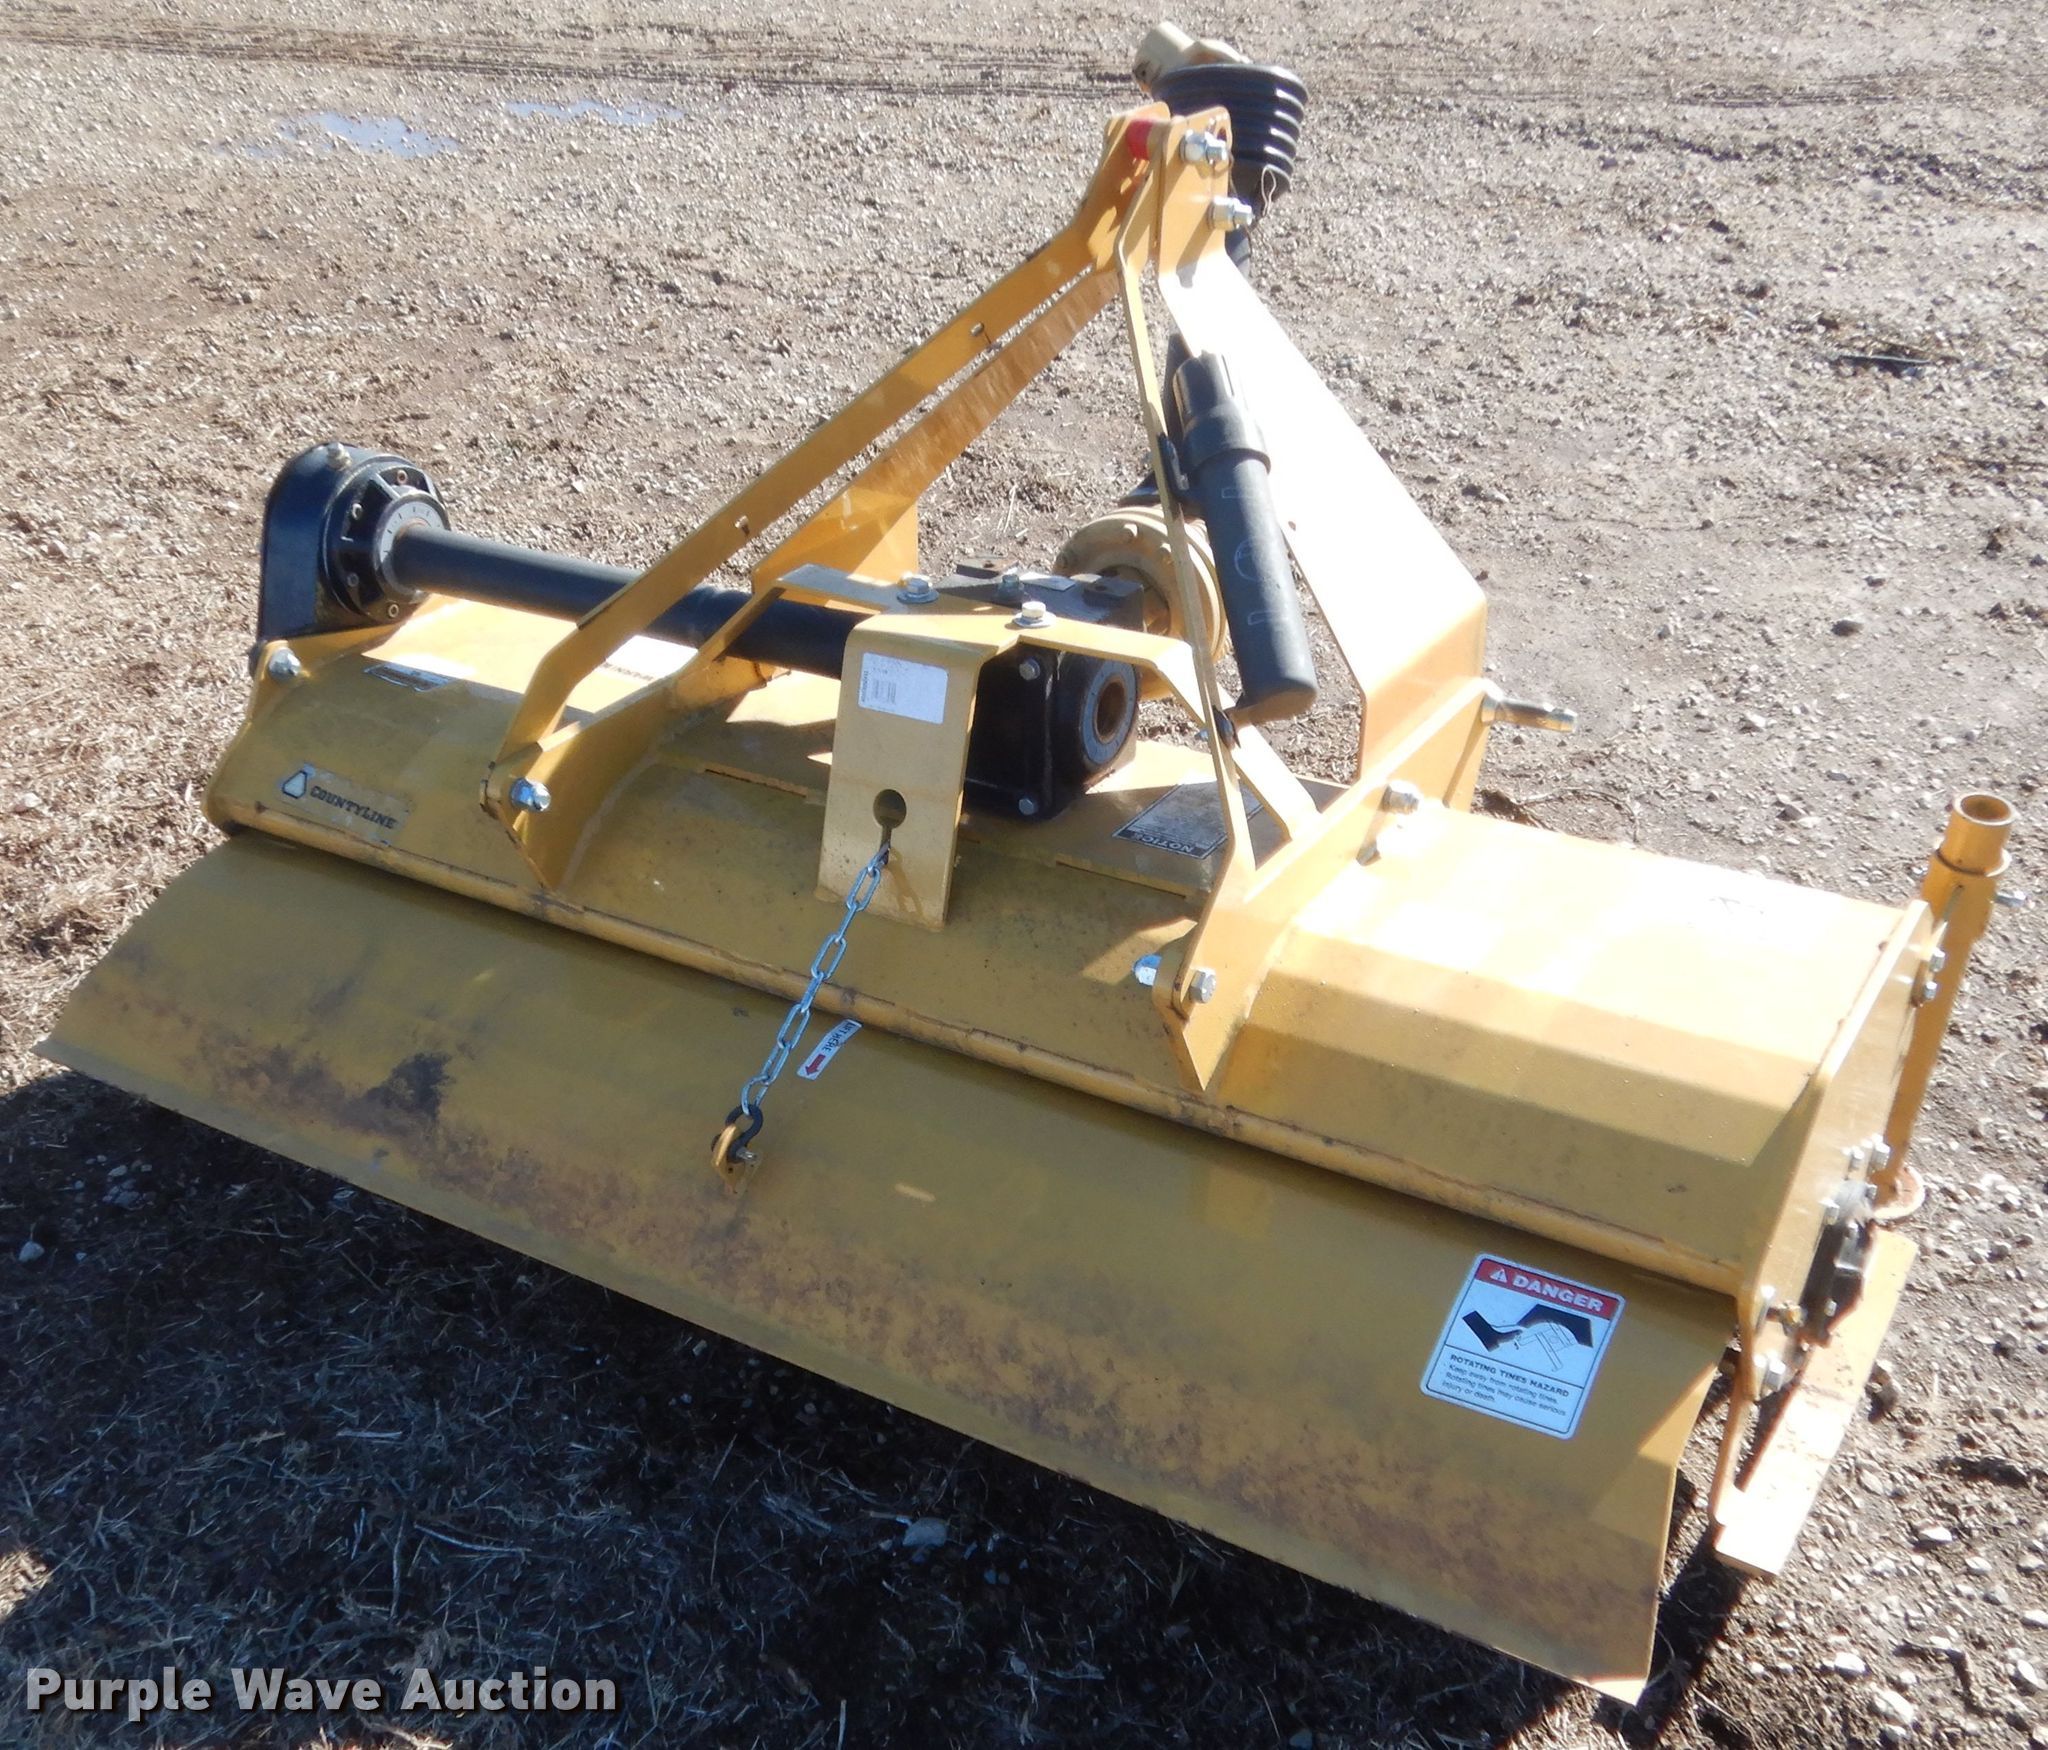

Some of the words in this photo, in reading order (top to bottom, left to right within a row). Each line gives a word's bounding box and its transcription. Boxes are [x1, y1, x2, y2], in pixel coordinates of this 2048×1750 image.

[310, 785, 398, 830] COUNTYLINE
[821, 1032, 842, 1052] HERE
[1512, 1273, 1604, 1312] DANGER
[1446, 1372, 1476, 1389] Rotating
[1477, 1381, 1495, 1394] tines
[1497, 1388, 1514, 1401] may
[1514, 1395, 1537, 1407] cause
[1538, 1402, 1566, 1416] serious
[1449, 1364, 1467, 1377] Keep
[1469, 1371, 1487, 1383] away
[1490, 1375, 1507, 1388] from
[1508, 1382, 1538, 1399] rotating
[1450, 1354, 1496, 1374] ROTATING
[1500, 1370, 1527, 1384] TINES
[1529, 1379, 1570, 1397] HAZARD
[1464, 1386, 1473, 1394] or
